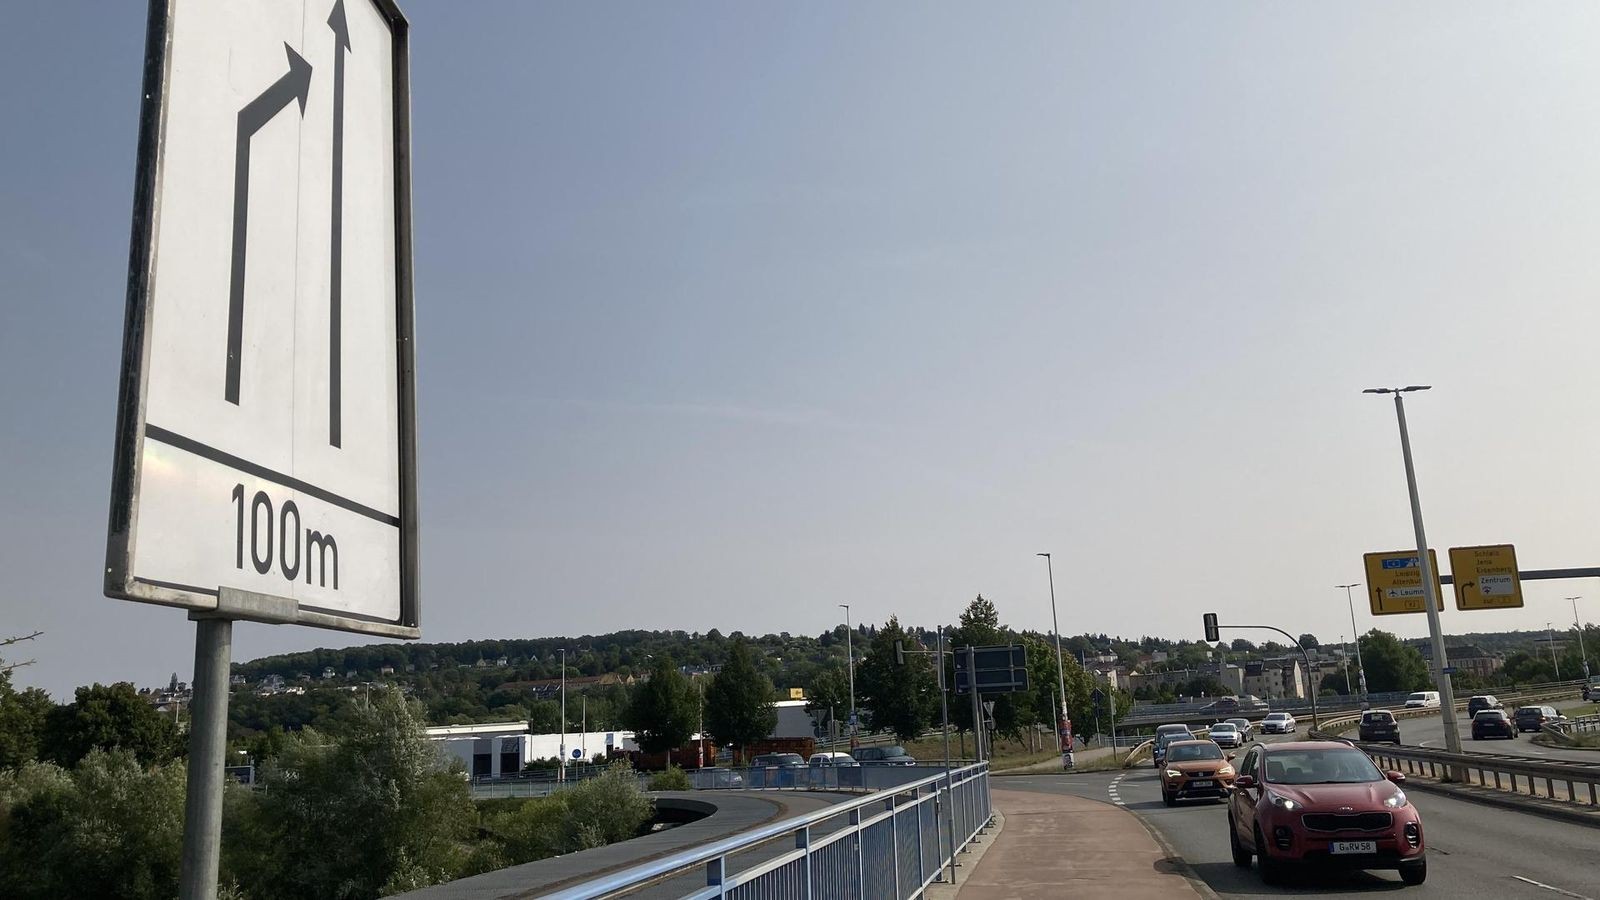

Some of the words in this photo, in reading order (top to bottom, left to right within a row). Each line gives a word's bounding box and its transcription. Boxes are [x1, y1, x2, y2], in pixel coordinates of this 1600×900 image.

[231, 483, 338, 590] 100m
[1392, 578, 1423, 586] Altenbur
[1481, 577, 1512, 585] Zentrum
